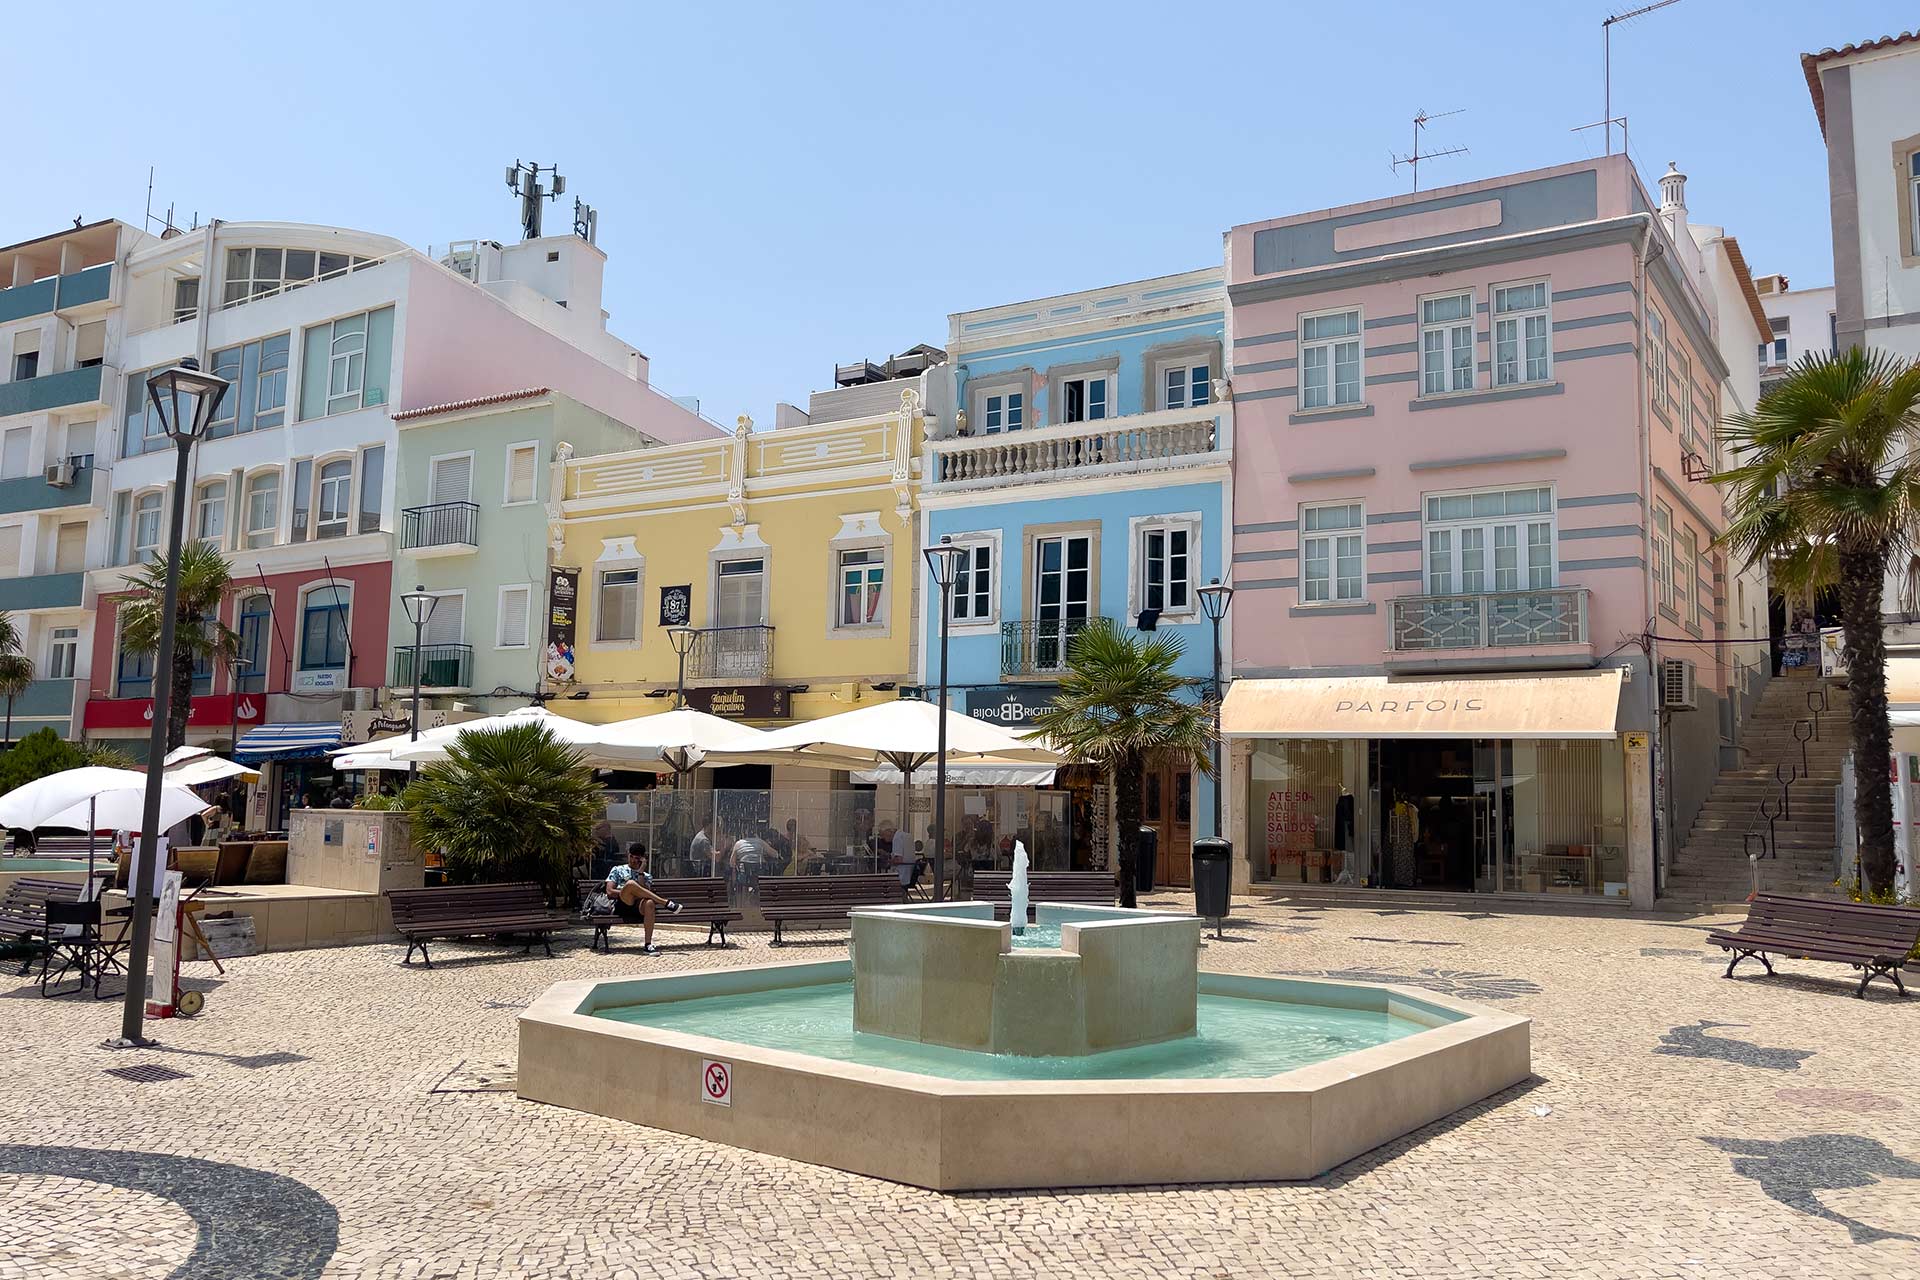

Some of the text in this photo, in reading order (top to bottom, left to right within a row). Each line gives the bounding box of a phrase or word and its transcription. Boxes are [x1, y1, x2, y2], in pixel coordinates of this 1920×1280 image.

[670, 599, 680, 610] 87
[1335, 699, 1483, 713] PARFOIS
[973, 708, 1000, 719] BIJOU
[1267, 822, 1316, 833] SALDOS
